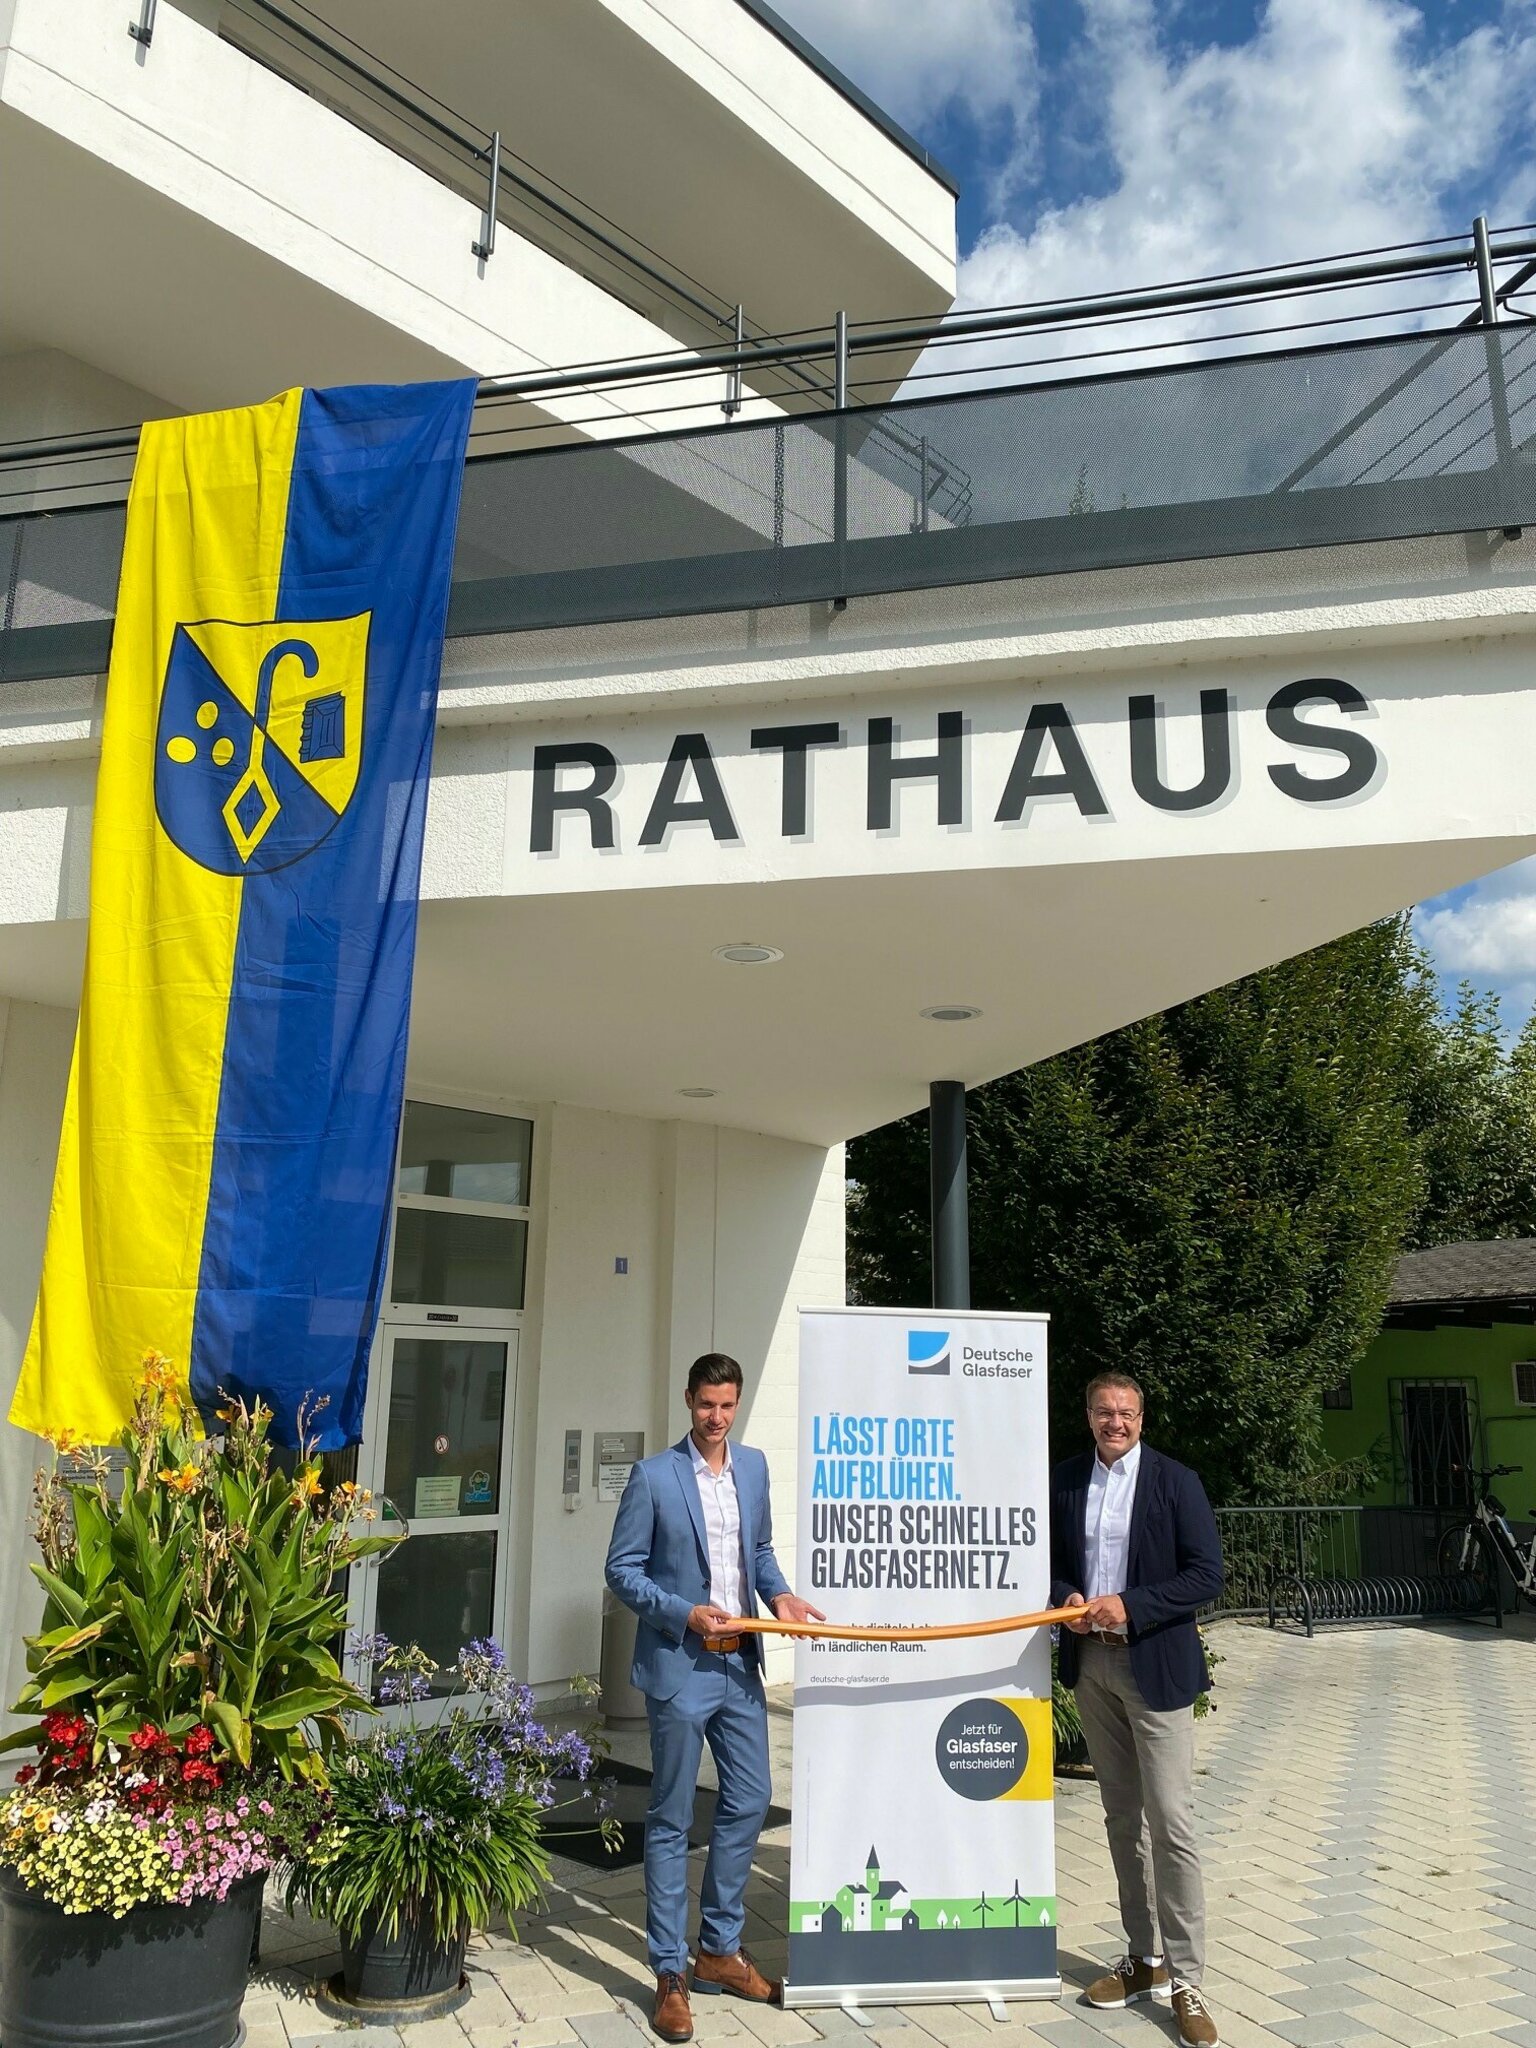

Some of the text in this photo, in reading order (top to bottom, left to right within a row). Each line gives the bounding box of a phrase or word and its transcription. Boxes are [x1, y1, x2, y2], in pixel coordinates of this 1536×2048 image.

[529, 678, 1381, 857] RATHAUS
[963, 1346, 1033, 1362] Deutsche
[962, 1363, 1033, 1378] Glasfaser
[814, 1413, 954, 1457] LÄSST ORTE
[812, 1457, 961, 1501] AUFBLÜHEN.
[812, 1504, 1036, 1546] UNSER SCHNELLES
[811, 1548, 1018, 1590] GLASFASERNETZ.
[811, 1641, 926, 1652] im ländlichen Raum.
[810, 1675, 890, 1685] deutsche-glasfaser.de
[961, 1724, 1002, 1735] Jetzt für
[946, 1739, 1018, 1753] Glasfaser
[949, 1758, 1015, 1769] entscheiden!
